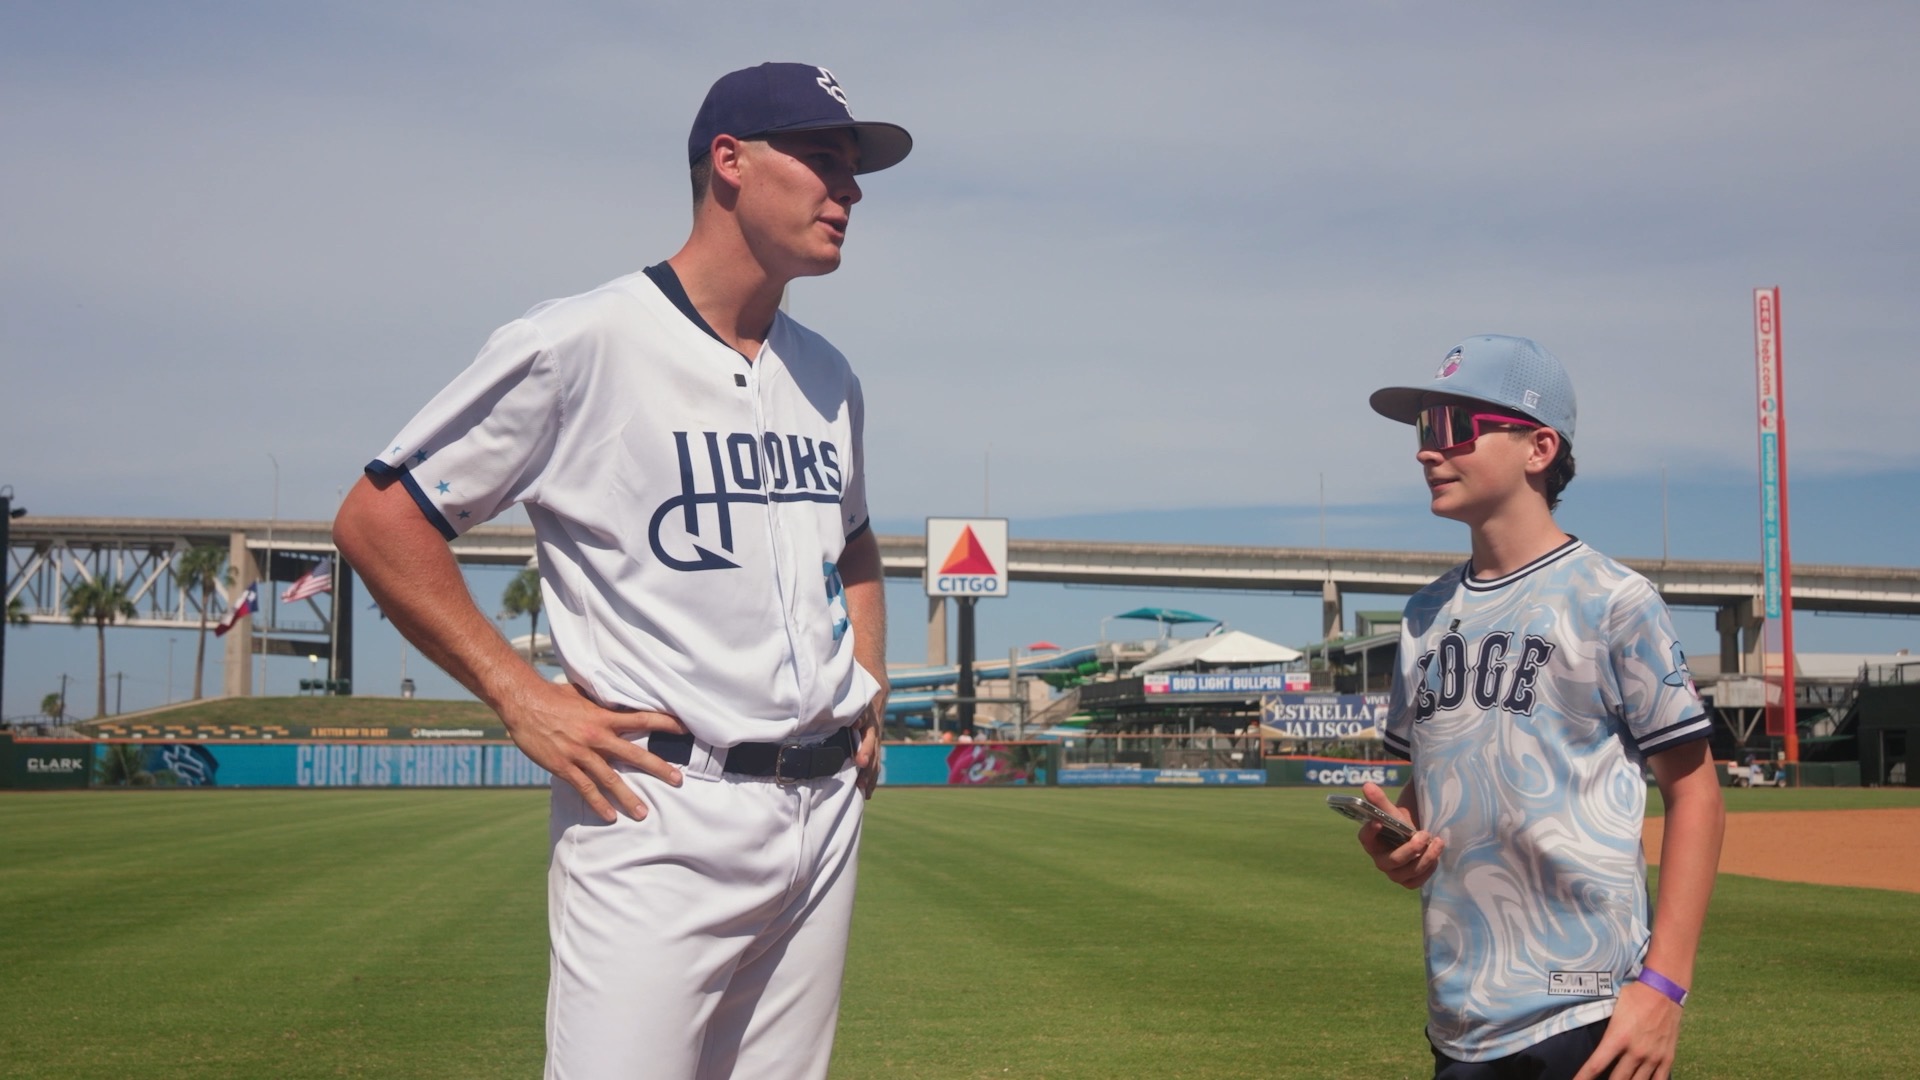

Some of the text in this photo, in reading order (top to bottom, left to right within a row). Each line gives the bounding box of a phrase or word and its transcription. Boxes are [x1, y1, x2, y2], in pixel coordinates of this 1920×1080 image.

[1761, 338, 1771, 396] heb.com
[648, 431, 842, 572] HOOKS
[938, 576, 998, 592] CITGO
[1172, 677, 1197, 690] BUD
[1198, 676, 1232, 690] LIGHT
[1233, 676, 1282, 689] BULLPEN
[1273, 704, 1372, 721] ESTRELLA
[1282, 721, 1363, 738] JALISCO
[27, 758, 83, 769] CLARK
[297, 745, 391, 785] CORPUS
[401, 745, 493, 785] CHRISTI
[1318, 769, 1385, 785] CC GAS
